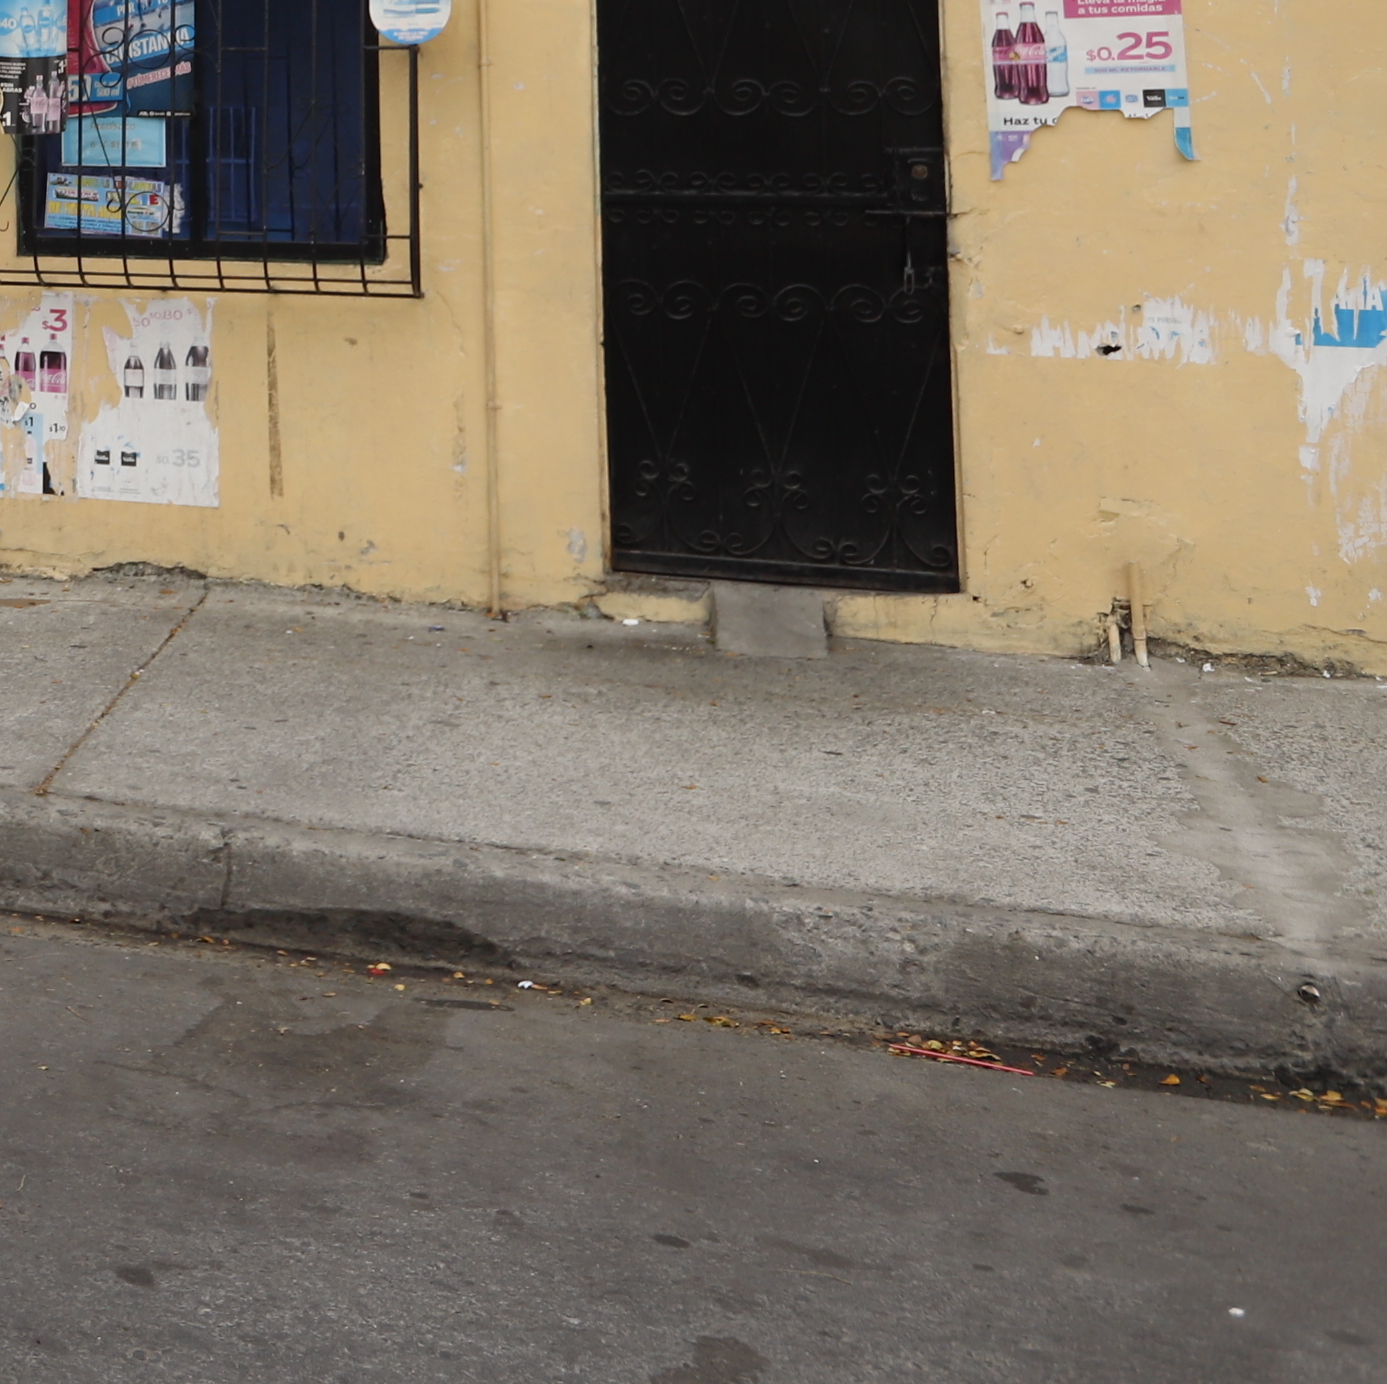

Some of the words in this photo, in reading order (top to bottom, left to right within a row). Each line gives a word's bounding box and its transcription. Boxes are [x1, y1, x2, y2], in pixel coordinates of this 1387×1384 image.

[1078, 7, 1086, 15] a
[1089, 5, 1108, 15] tus
[1111, 3, 1163, 14] comidas
[1085, 30, 1174, 63] $0.25
[1003, 117, 1029, 126] Haz
[1033, 116, 1049, 126] tu
[42, 308, 68, 332] $3
